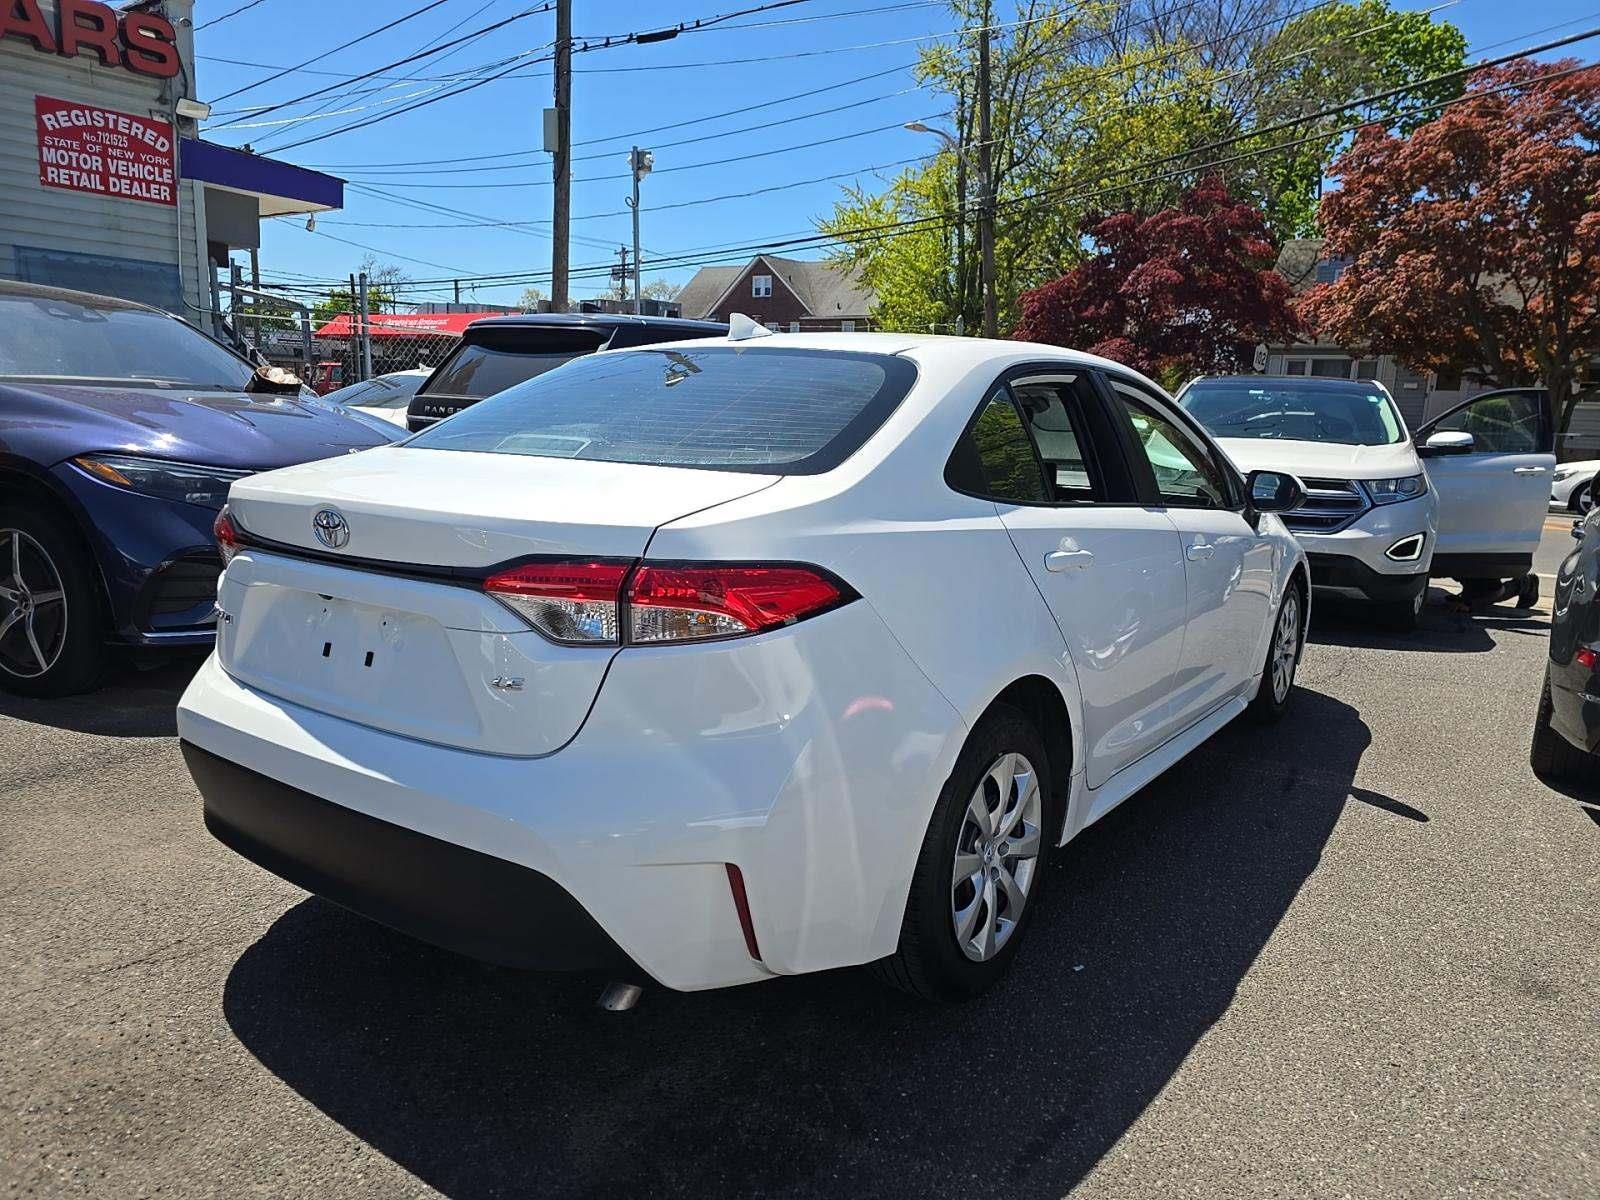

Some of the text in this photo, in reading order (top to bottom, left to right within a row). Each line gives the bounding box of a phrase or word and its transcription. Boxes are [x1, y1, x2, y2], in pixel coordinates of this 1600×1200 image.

[42, 109, 170, 153] REGISTERED
[42, 146, 173, 184] MOTOR VEHICLE
[44, 135, 170, 166] STATE OF NEW YORK
[47, 166, 171, 201] RETAIL DEALER
